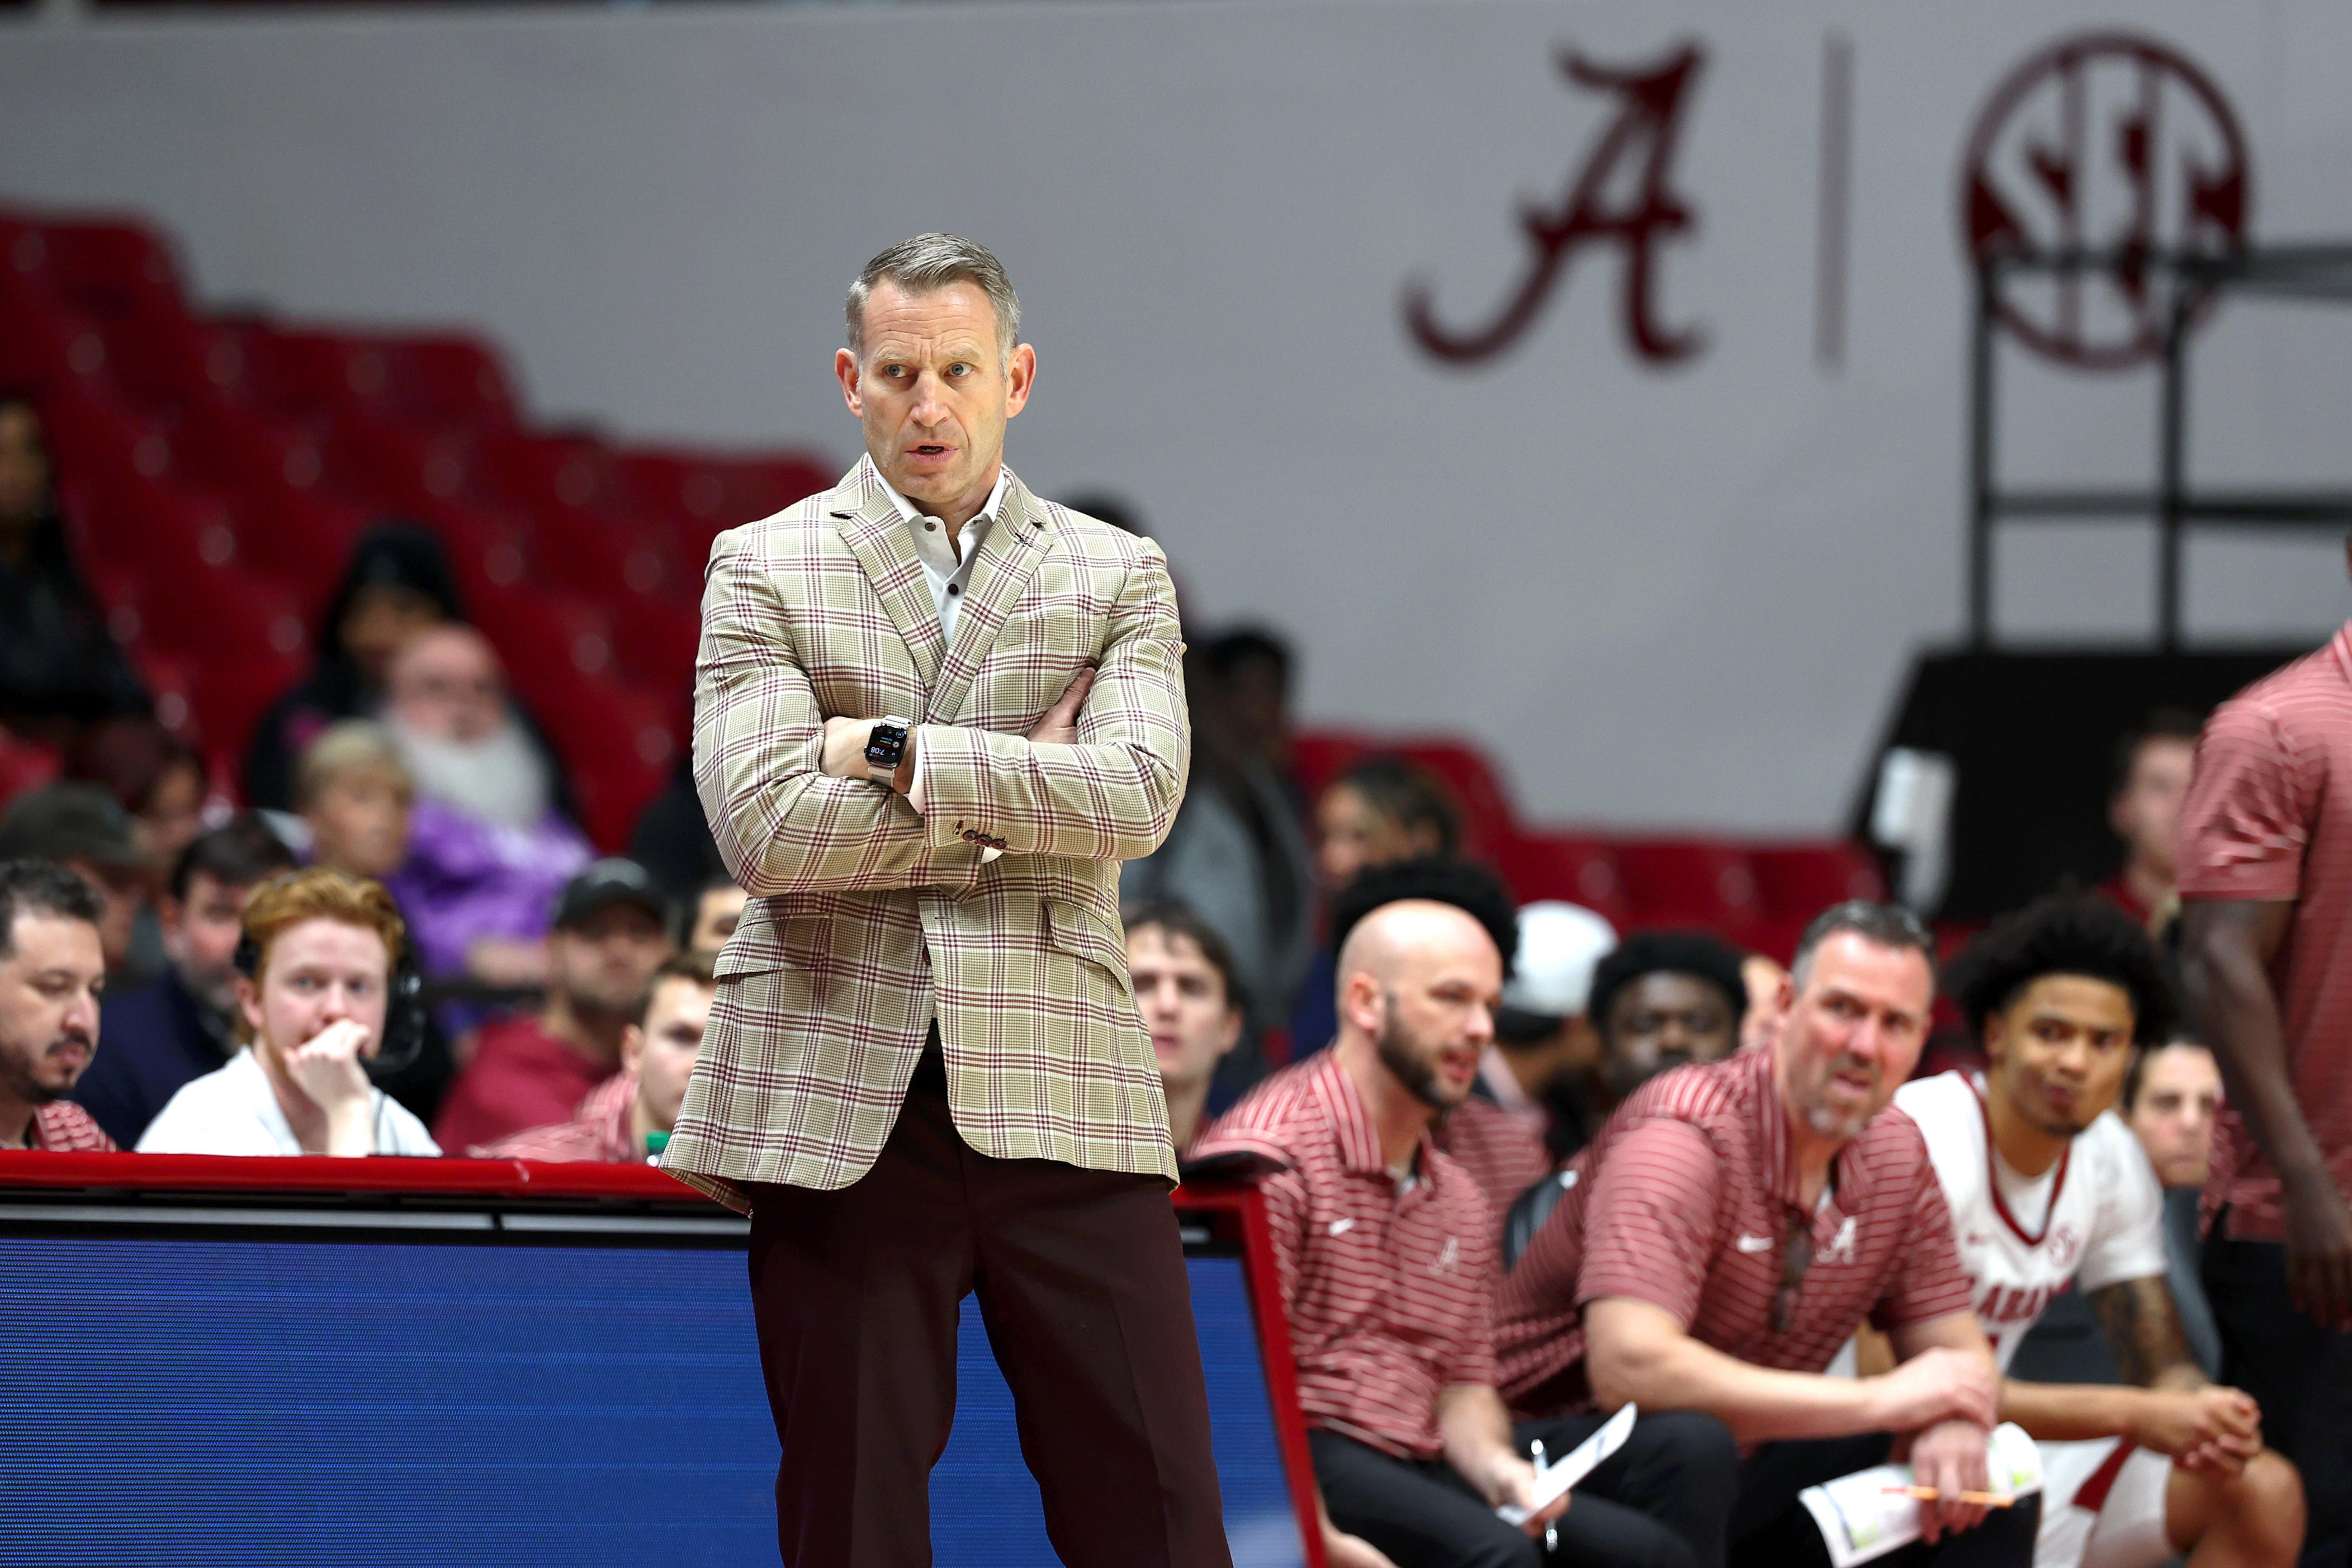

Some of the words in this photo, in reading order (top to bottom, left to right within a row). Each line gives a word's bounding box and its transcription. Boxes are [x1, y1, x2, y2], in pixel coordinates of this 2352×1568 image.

[1401, 34, 1707, 370] A
[870, 747, 884, 755] 7:08
[1816, 1216, 1856, 1264] A
